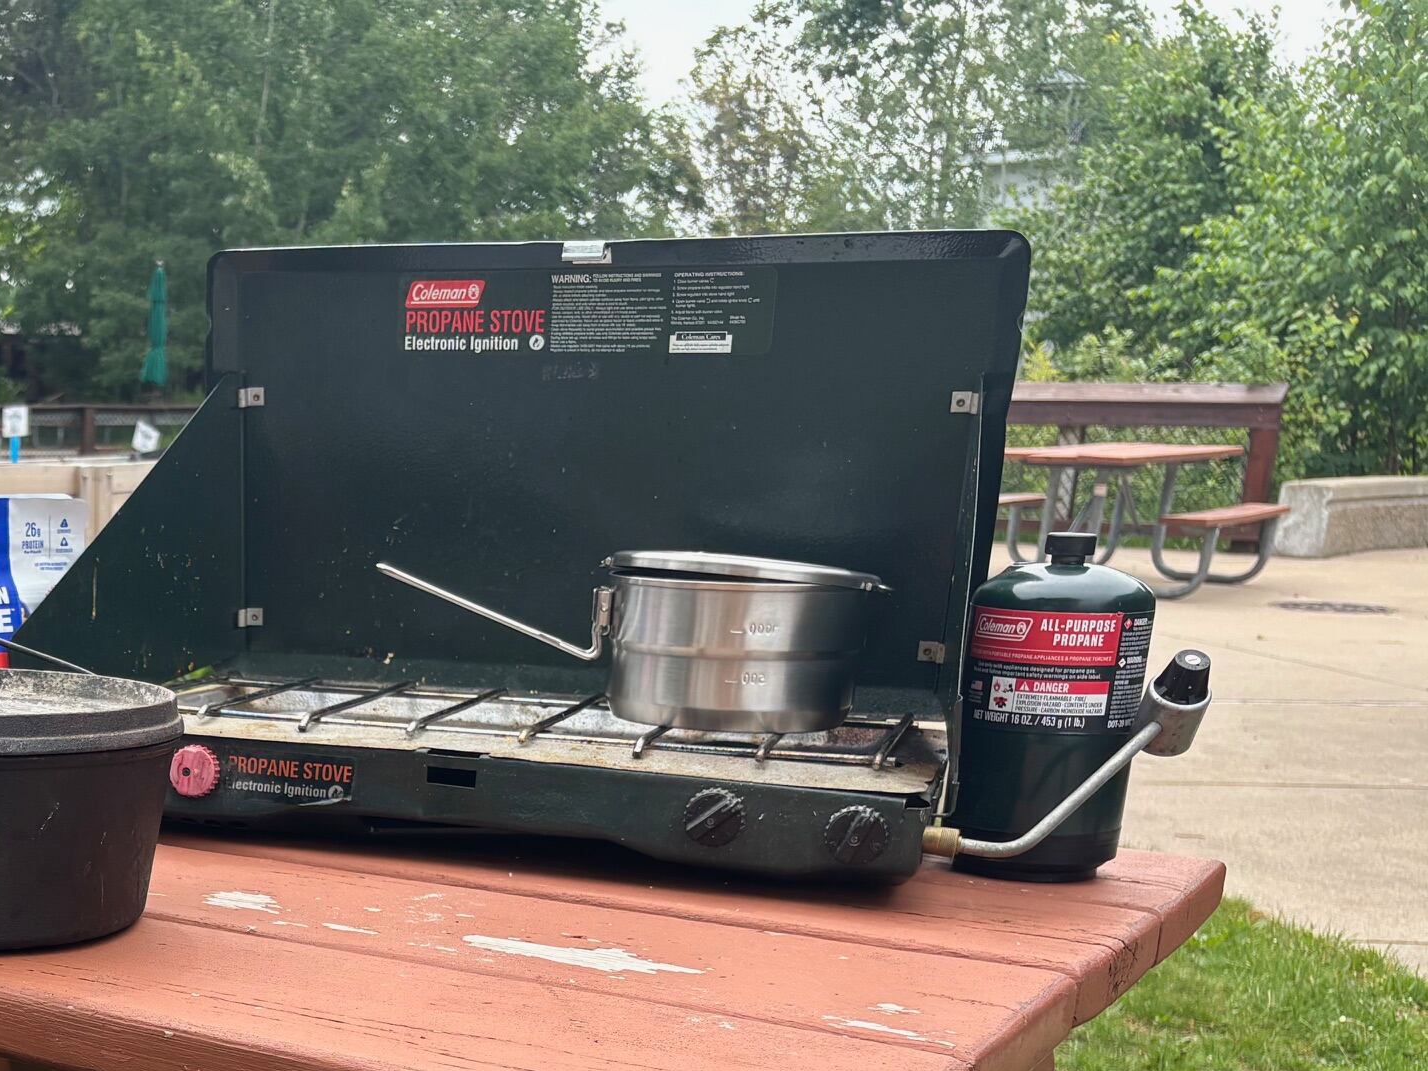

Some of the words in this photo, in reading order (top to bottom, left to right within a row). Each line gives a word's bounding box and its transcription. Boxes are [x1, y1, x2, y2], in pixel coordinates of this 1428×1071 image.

[551, 274, 592, 284] WARNING:
[412, 284, 467, 301] Coleman
[405, 310, 485, 333] PROPANE
[489, 309, 546, 333] STOVE
[404, 335, 467, 351] Electronic
[470, 335, 519, 353] Ignition
[21, 540, 44, 549] PROTEIN
[979, 617, 1016, 634] Coleman
[1040, 618, 1117, 633] ALL-PURPOSE
[1052, 633, 1105, 647] PROPANE
[1033, 682, 1070, 693] DANGER
[984, 710, 1010, 723] WEIGHT
[1010, 714, 1019, 725] 16
[1040, 716, 1056, 726] 453
[1057, 718, 1063, 728] g
[228, 755, 299, 778] PROPANE
[303, 762, 352, 783] STOVE
[229, 780, 281, 794] lectronic
[284, 782, 327, 798] Ignition
